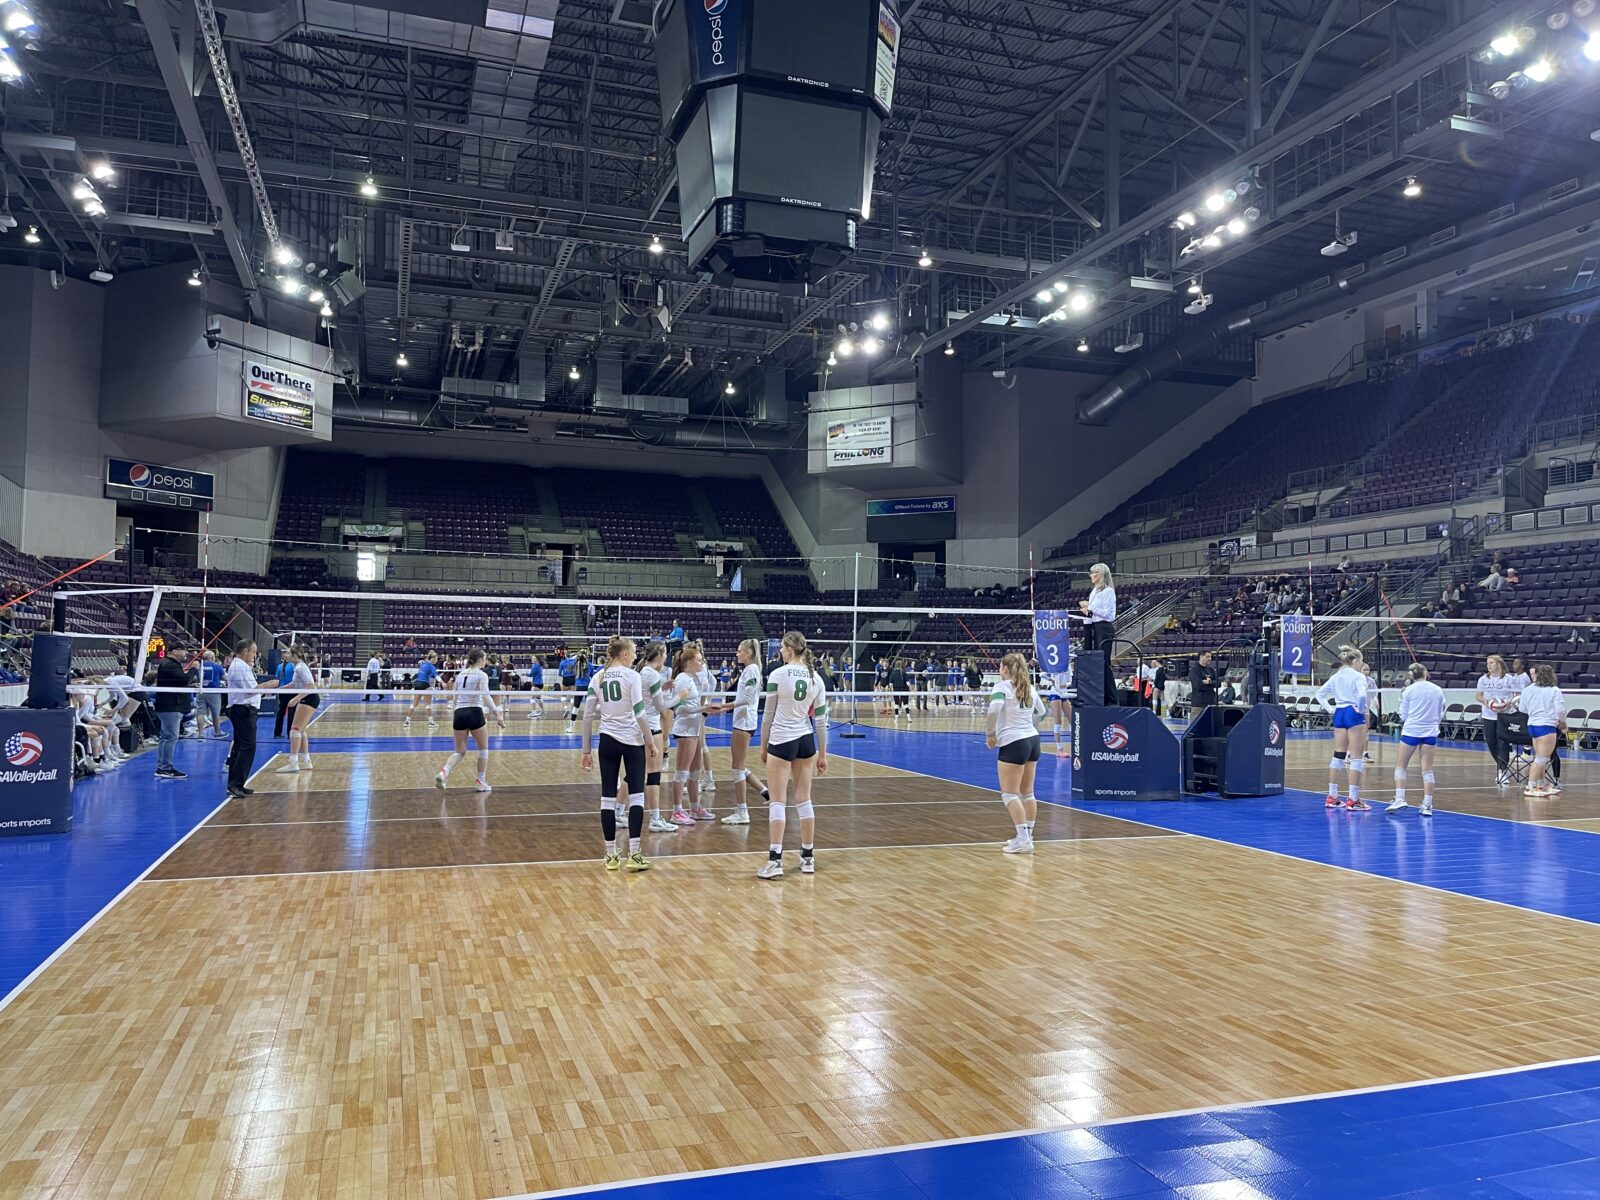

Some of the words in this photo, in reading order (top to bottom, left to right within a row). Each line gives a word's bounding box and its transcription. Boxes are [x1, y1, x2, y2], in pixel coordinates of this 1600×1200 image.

[708, 15, 725, 65] pepsi
[787, 75, 829, 88] DAKTRONICS
[780, 197, 822, 207] DAKTRONICS
[252, 365, 312, 392] OutThere
[153, 474, 194, 489] pepsi
[932, 501, 949, 509] axs
[1035, 619, 1069, 630] COURT
[1283, 622, 1311, 634] COURT
[1046, 644, 1059, 666] 3
[1291, 646, 1303, 667] 2
[601, 671, 623, 679] OSSIL
[787, 669, 809, 678] FOSSI
[462, 676, 468, 688] 1
[599, 680, 623, 703] 10
[794, 679, 808, 702] 8
[1091, 752, 1140, 763] USAVolleyball
[19, 818, 52, 828] imports
